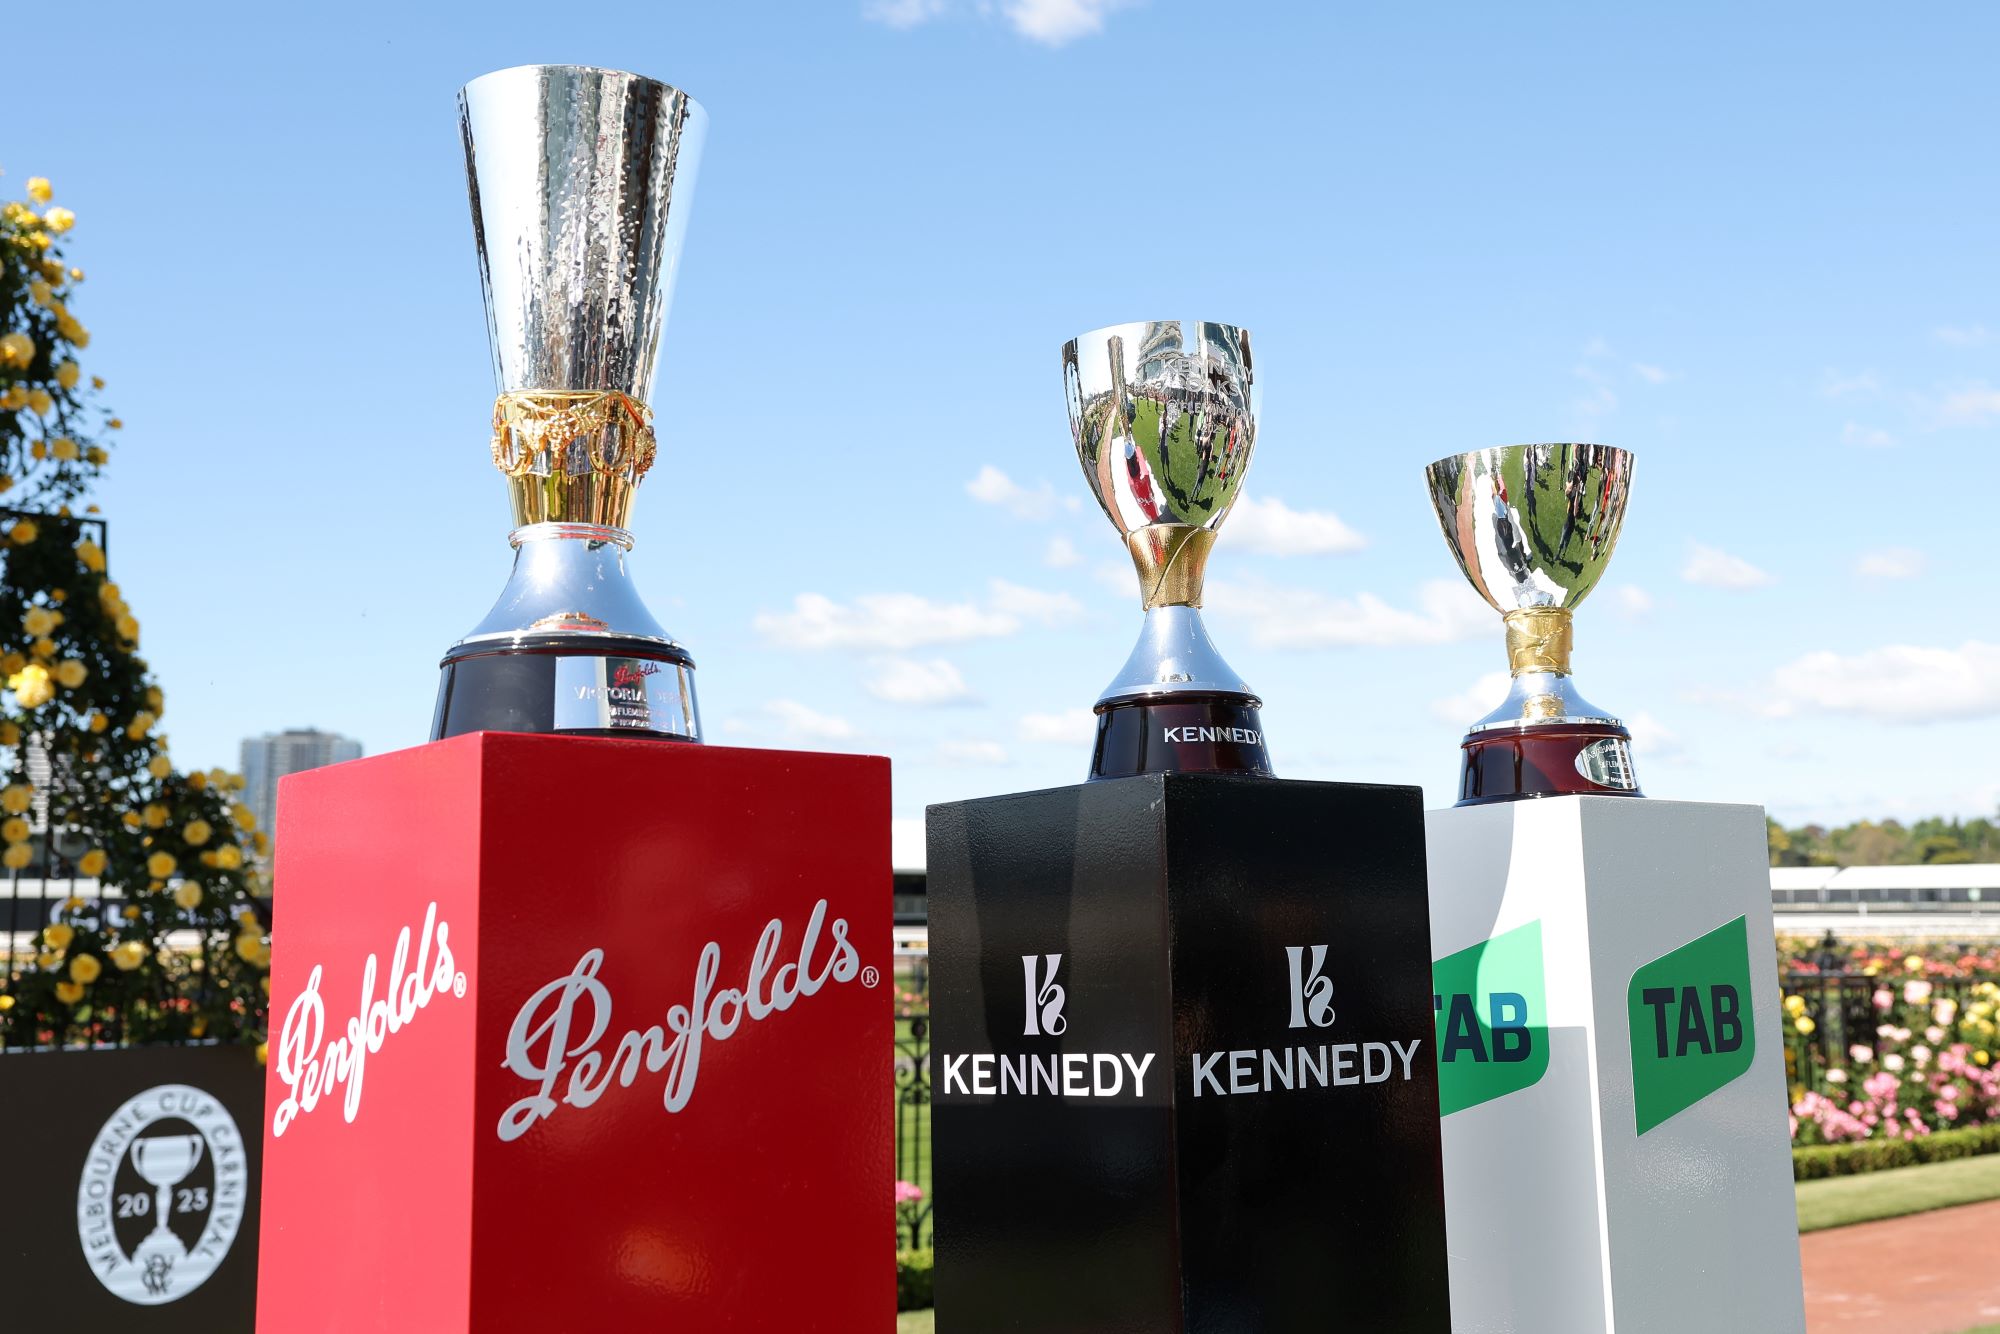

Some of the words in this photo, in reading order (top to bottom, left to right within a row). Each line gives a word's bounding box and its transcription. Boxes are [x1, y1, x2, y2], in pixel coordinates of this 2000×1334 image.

[1164, 726, 1262, 746] KENNEDY
[1433, 992, 1532, 1063] AB
[1642, 984, 1743, 1058] TAB
[943, 1053, 1156, 1098] KENNEDY
[1192, 1039, 1422, 1097] KENNEDY
[86, 1102, 148, 1278] MELBOURNE
[158, 1092, 214, 1119] CUP
[200, 1123, 241, 1258] CARNIVAL
[116, 1192, 150, 1219] 20
